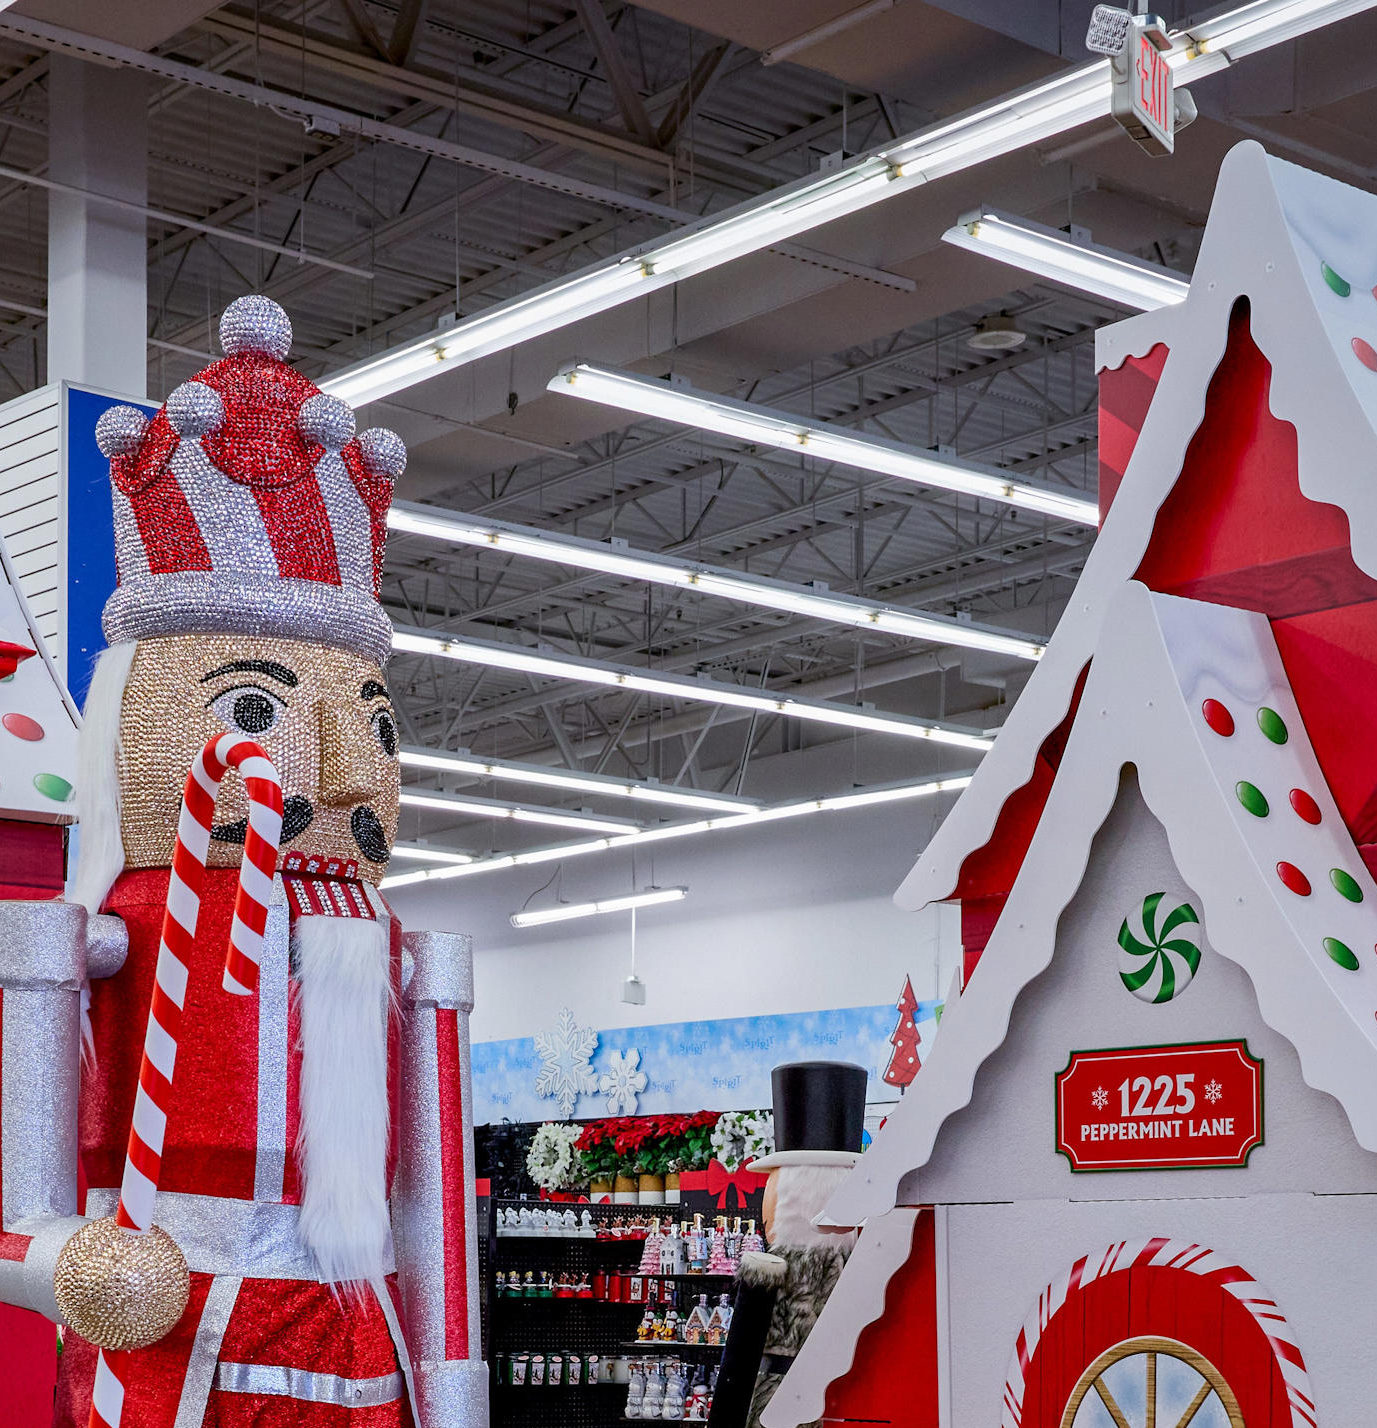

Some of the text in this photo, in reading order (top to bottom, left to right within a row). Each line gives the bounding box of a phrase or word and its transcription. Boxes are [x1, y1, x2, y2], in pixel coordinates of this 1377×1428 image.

[1140, 36, 1170, 132] EXIT
[1117, 1073, 1196, 1117] 1225
[1080, 1117, 1235, 1142] PEPPERMINT LANE
